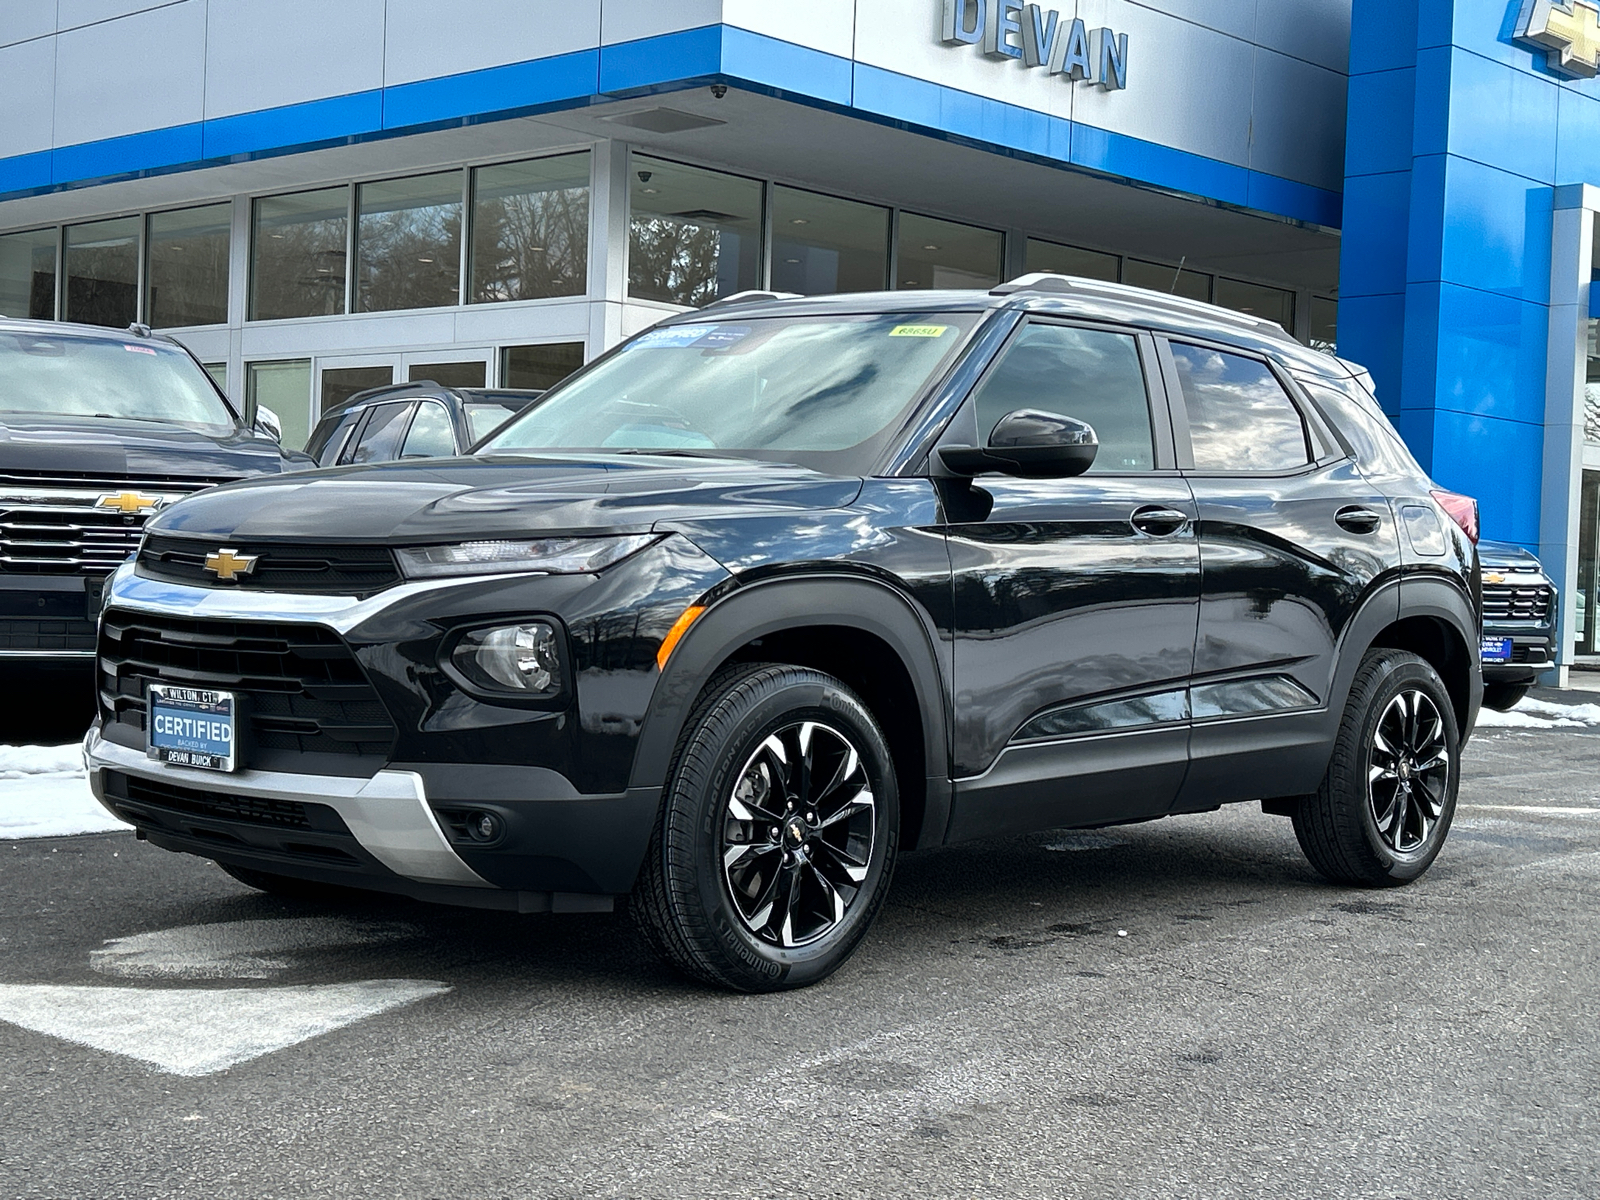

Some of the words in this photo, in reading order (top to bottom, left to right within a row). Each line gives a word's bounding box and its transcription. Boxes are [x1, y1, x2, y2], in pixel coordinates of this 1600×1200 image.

[942, 0, 1128, 91] DEVAN
[202, 692, 212, 703] CT
[155, 714, 231, 742] CERTIFIED
[178, 739, 199, 750] BACKED
[200, 741, 208, 750] BY
[168, 751, 189, 764] DEVAN
[191, 754, 212, 767] BUICK
